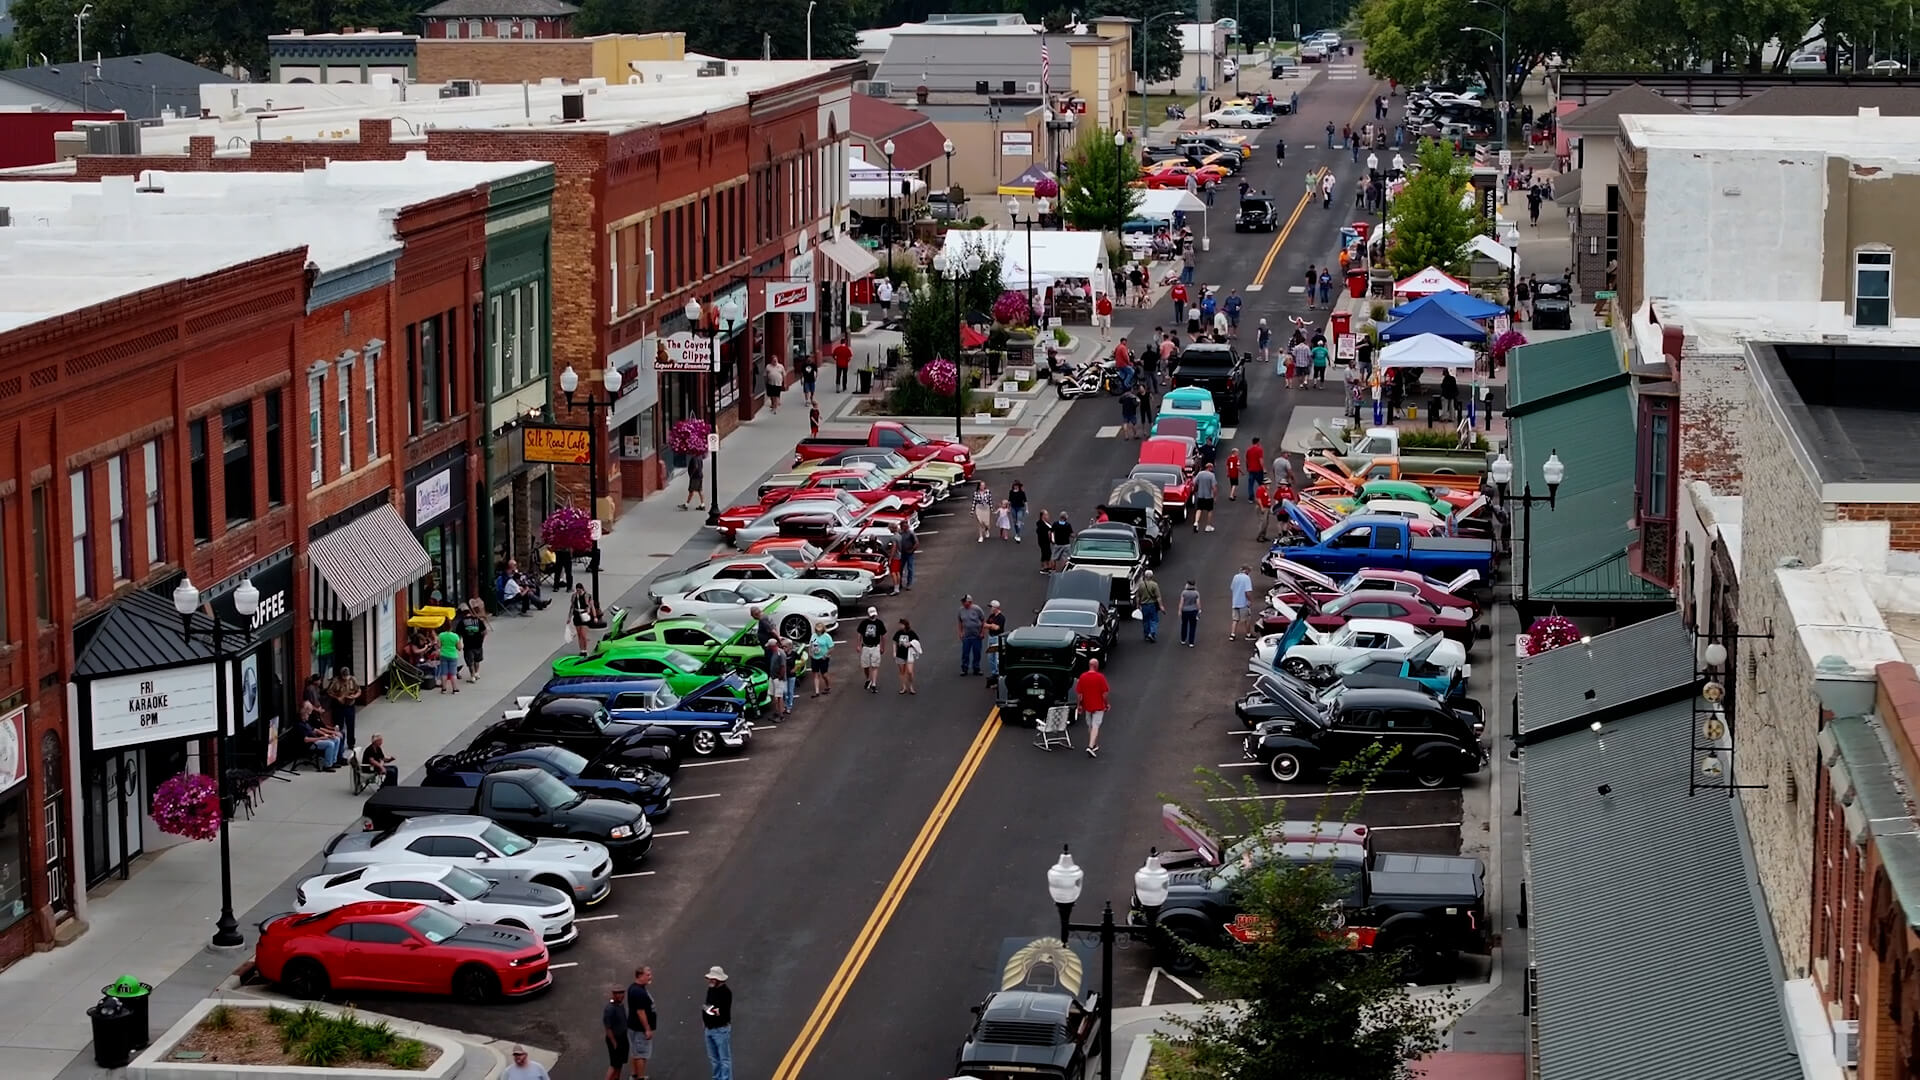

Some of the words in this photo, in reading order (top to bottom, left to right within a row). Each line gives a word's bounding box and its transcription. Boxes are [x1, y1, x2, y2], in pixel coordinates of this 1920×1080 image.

[667, 340, 681, 349] The
[682, 351, 711, 362] Clippe
[527, 430, 543, 447] Silk
[546, 430, 565, 449] Road
[249, 590, 285, 631] OFFEE
[140, 680, 154, 695] FRI
[129, 694, 168, 712] KARAOKE
[140, 712, 158, 727] 8PM
